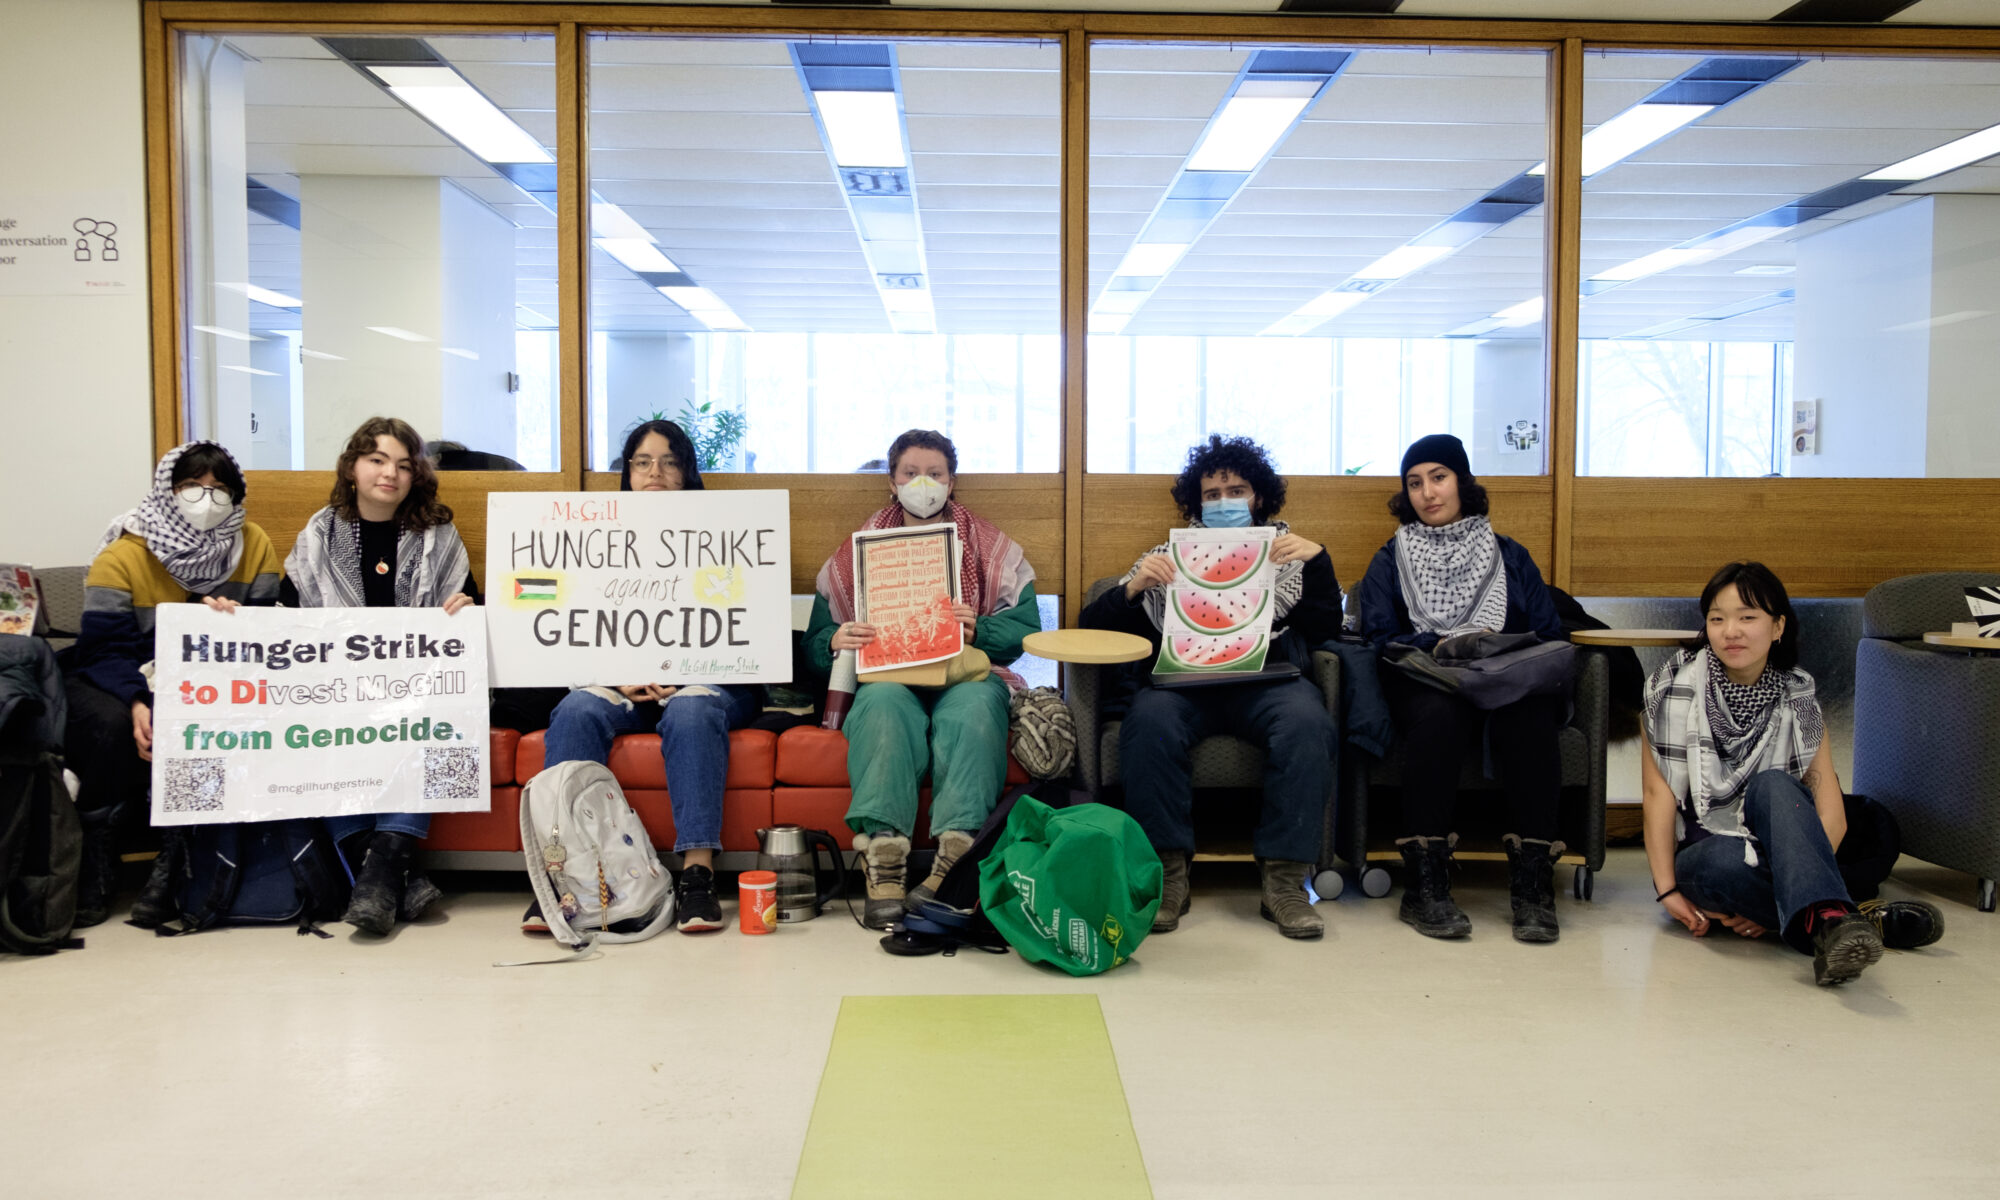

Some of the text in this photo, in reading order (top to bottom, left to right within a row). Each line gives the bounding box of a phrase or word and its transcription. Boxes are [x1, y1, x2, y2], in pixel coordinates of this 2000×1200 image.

[0, 219, 17, 231] ge
[551, 500, 618, 521] McGill
[511, 529, 777, 570] HUNGER STRIKE
[911, 546, 943, 557] PALESTINE
[912, 566, 944, 576] PALESTINE
[604, 574, 682, 605] against
[533, 607, 750, 648] GENOCIDE
[181, 633, 465, 670] Hunger Strike
[179, 671, 466, 705] to Divest McGill
[183, 718, 464, 750] from Genocide.
[267, 778, 383, 795] @mcgillhungerstrike
